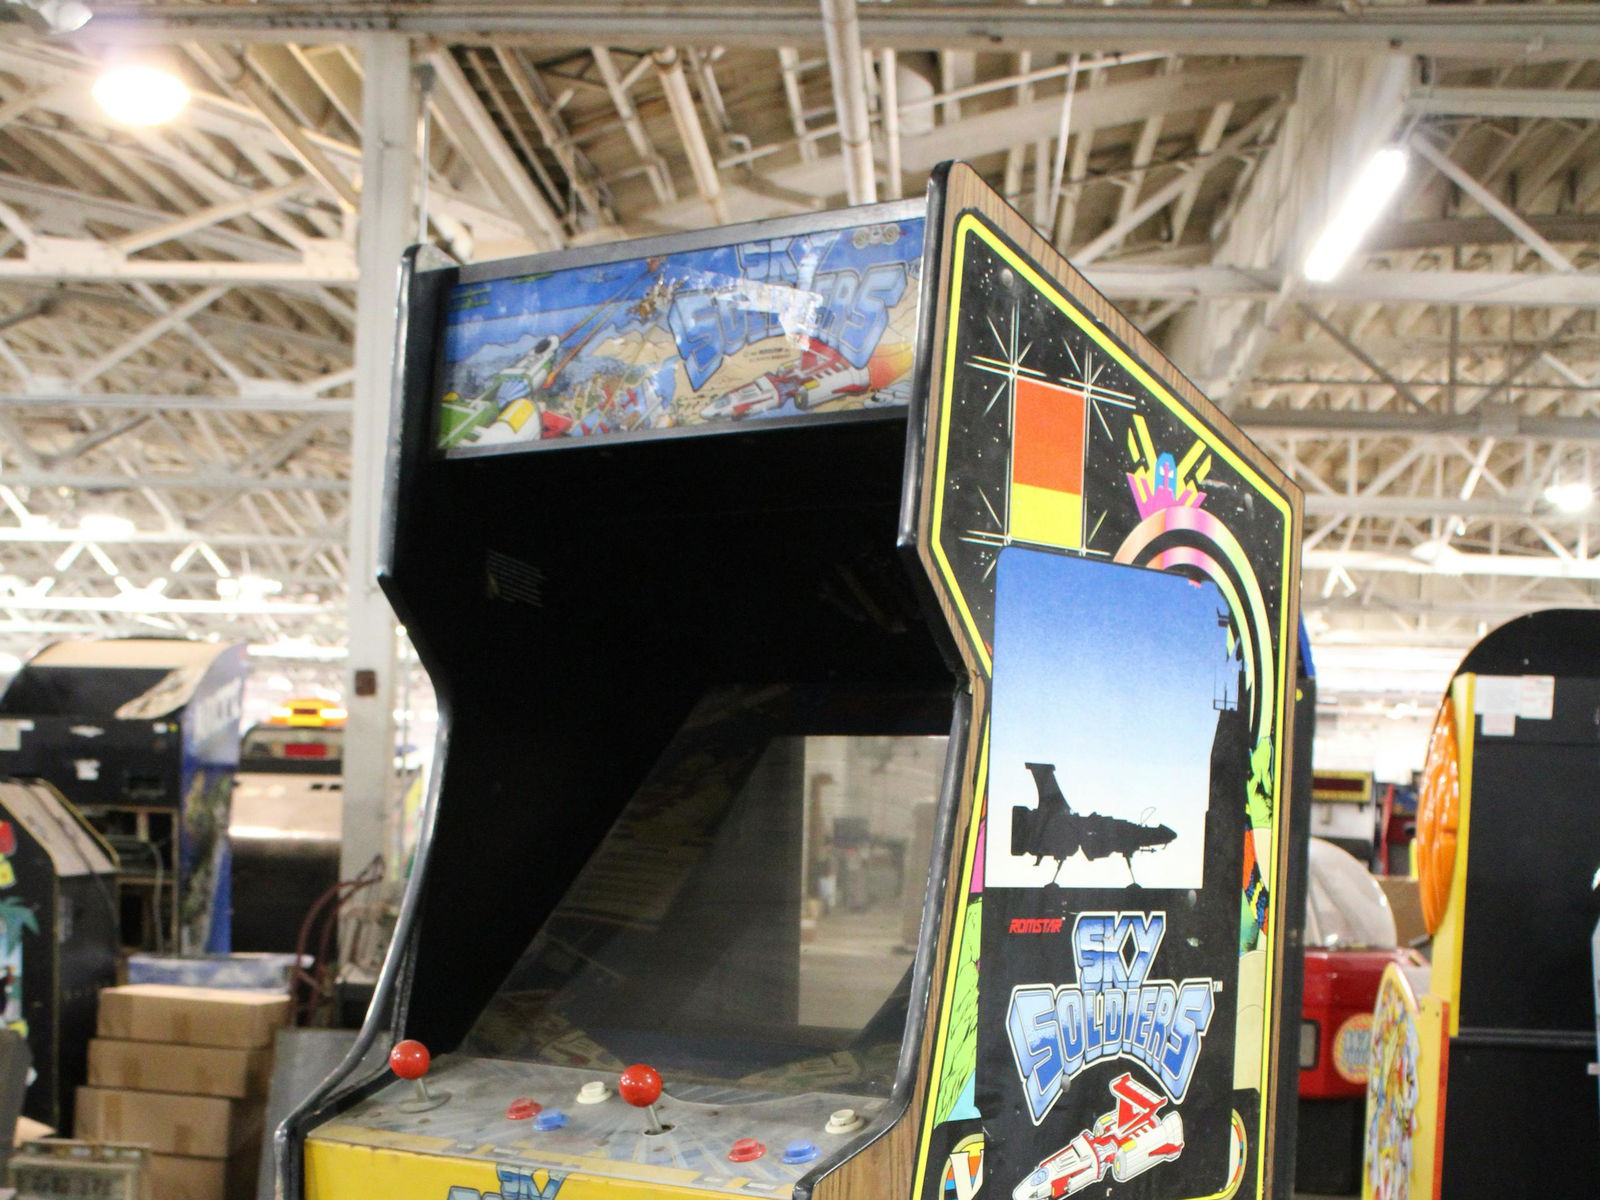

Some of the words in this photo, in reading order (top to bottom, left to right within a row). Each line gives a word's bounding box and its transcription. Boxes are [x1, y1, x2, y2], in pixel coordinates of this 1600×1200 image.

[736, 234, 842, 290] SKY
[667, 261, 908, 392] SOLERS
[1009, 917, 1063, 934] ROMSTAR
[1072, 911, 1166, 984] SKY
[1006, 977, 1215, 1126] SOLDIERS
